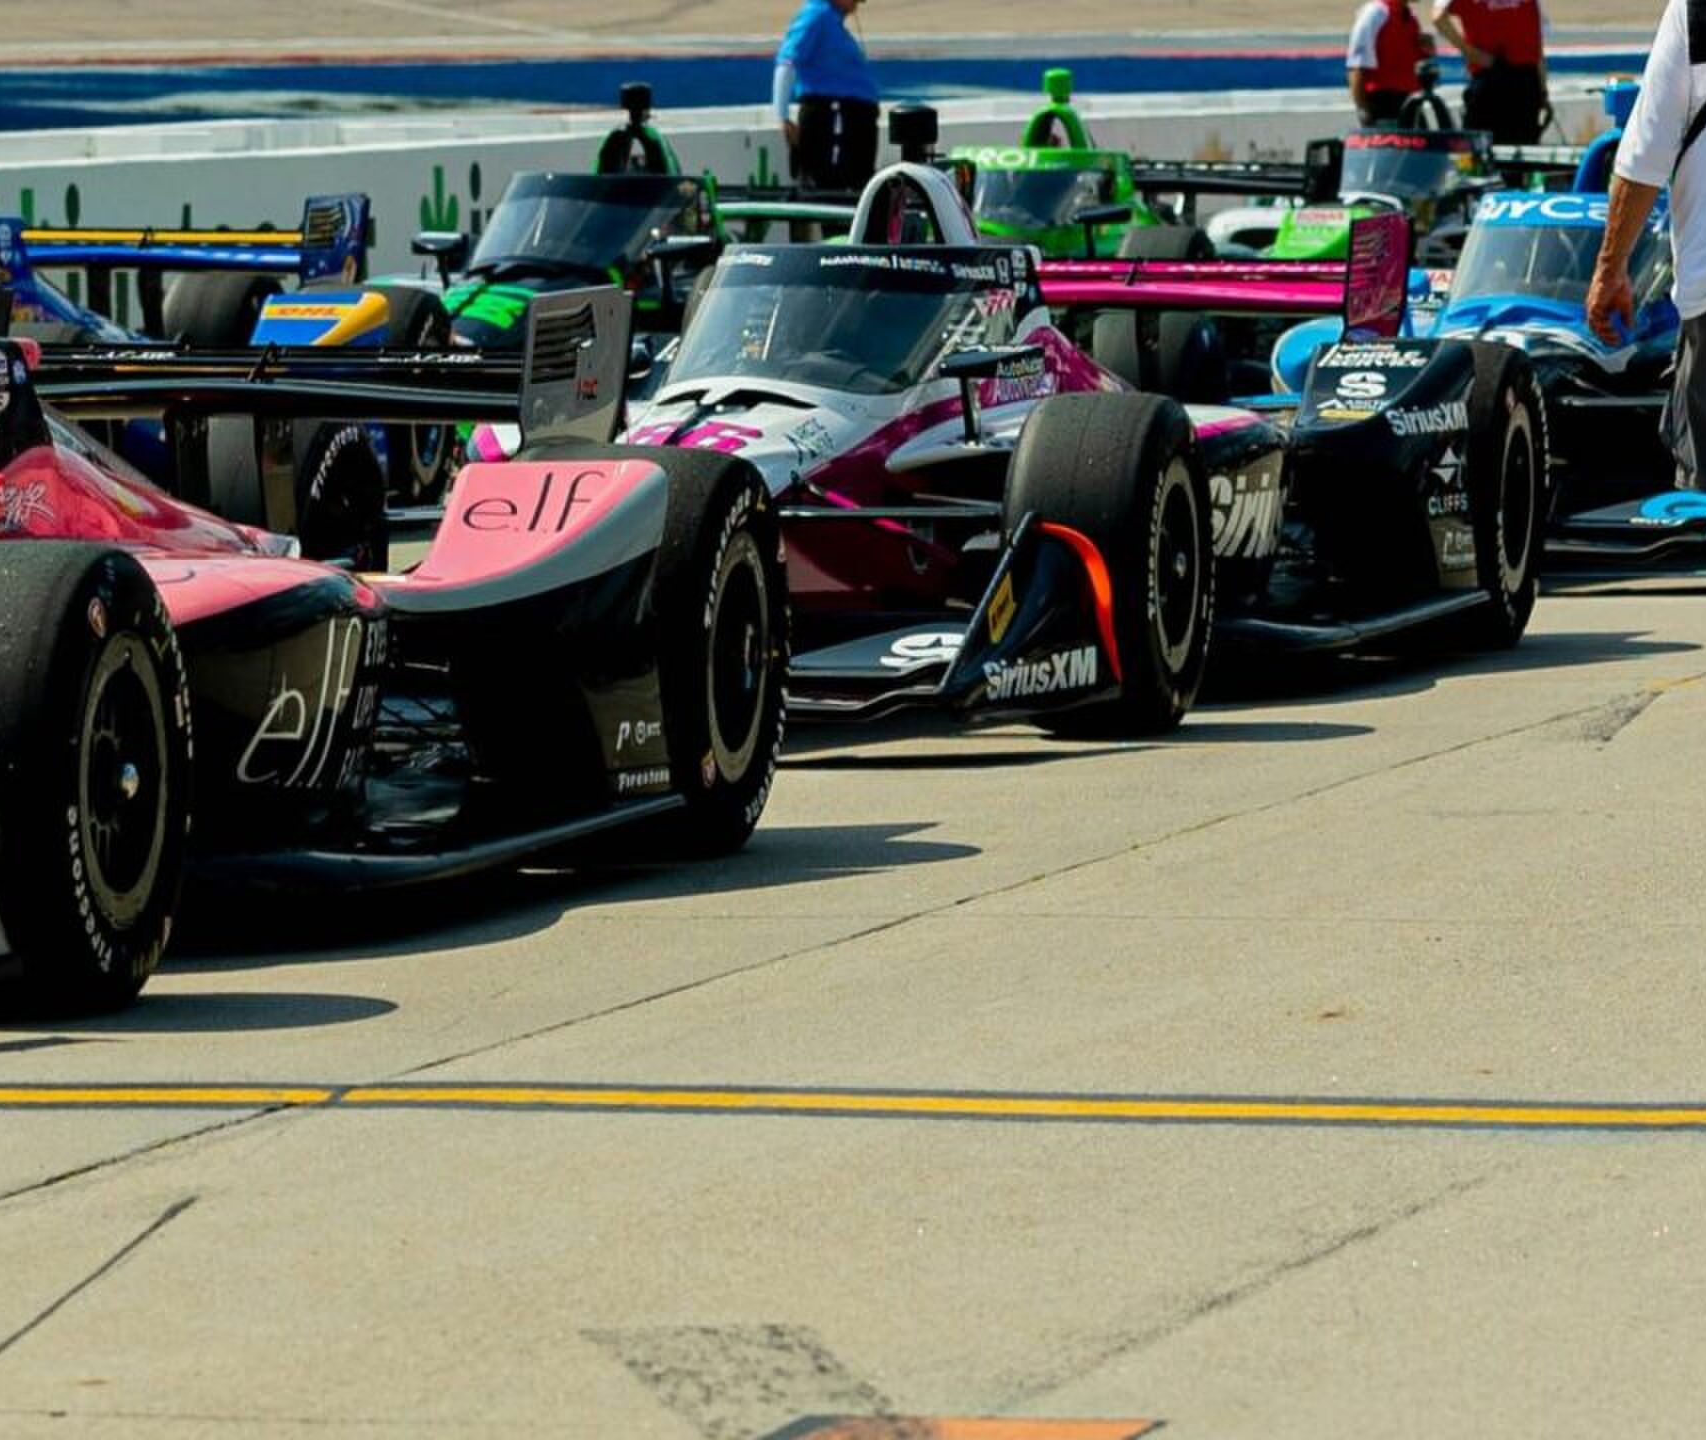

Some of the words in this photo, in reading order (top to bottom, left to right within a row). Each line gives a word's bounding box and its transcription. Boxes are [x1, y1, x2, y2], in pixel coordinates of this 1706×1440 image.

[1386, 400, 1470, 437] SiriusXM
[1428, 492, 1469, 516] CLIFFS
[982, 645, 1099, 701] SiriusXM
